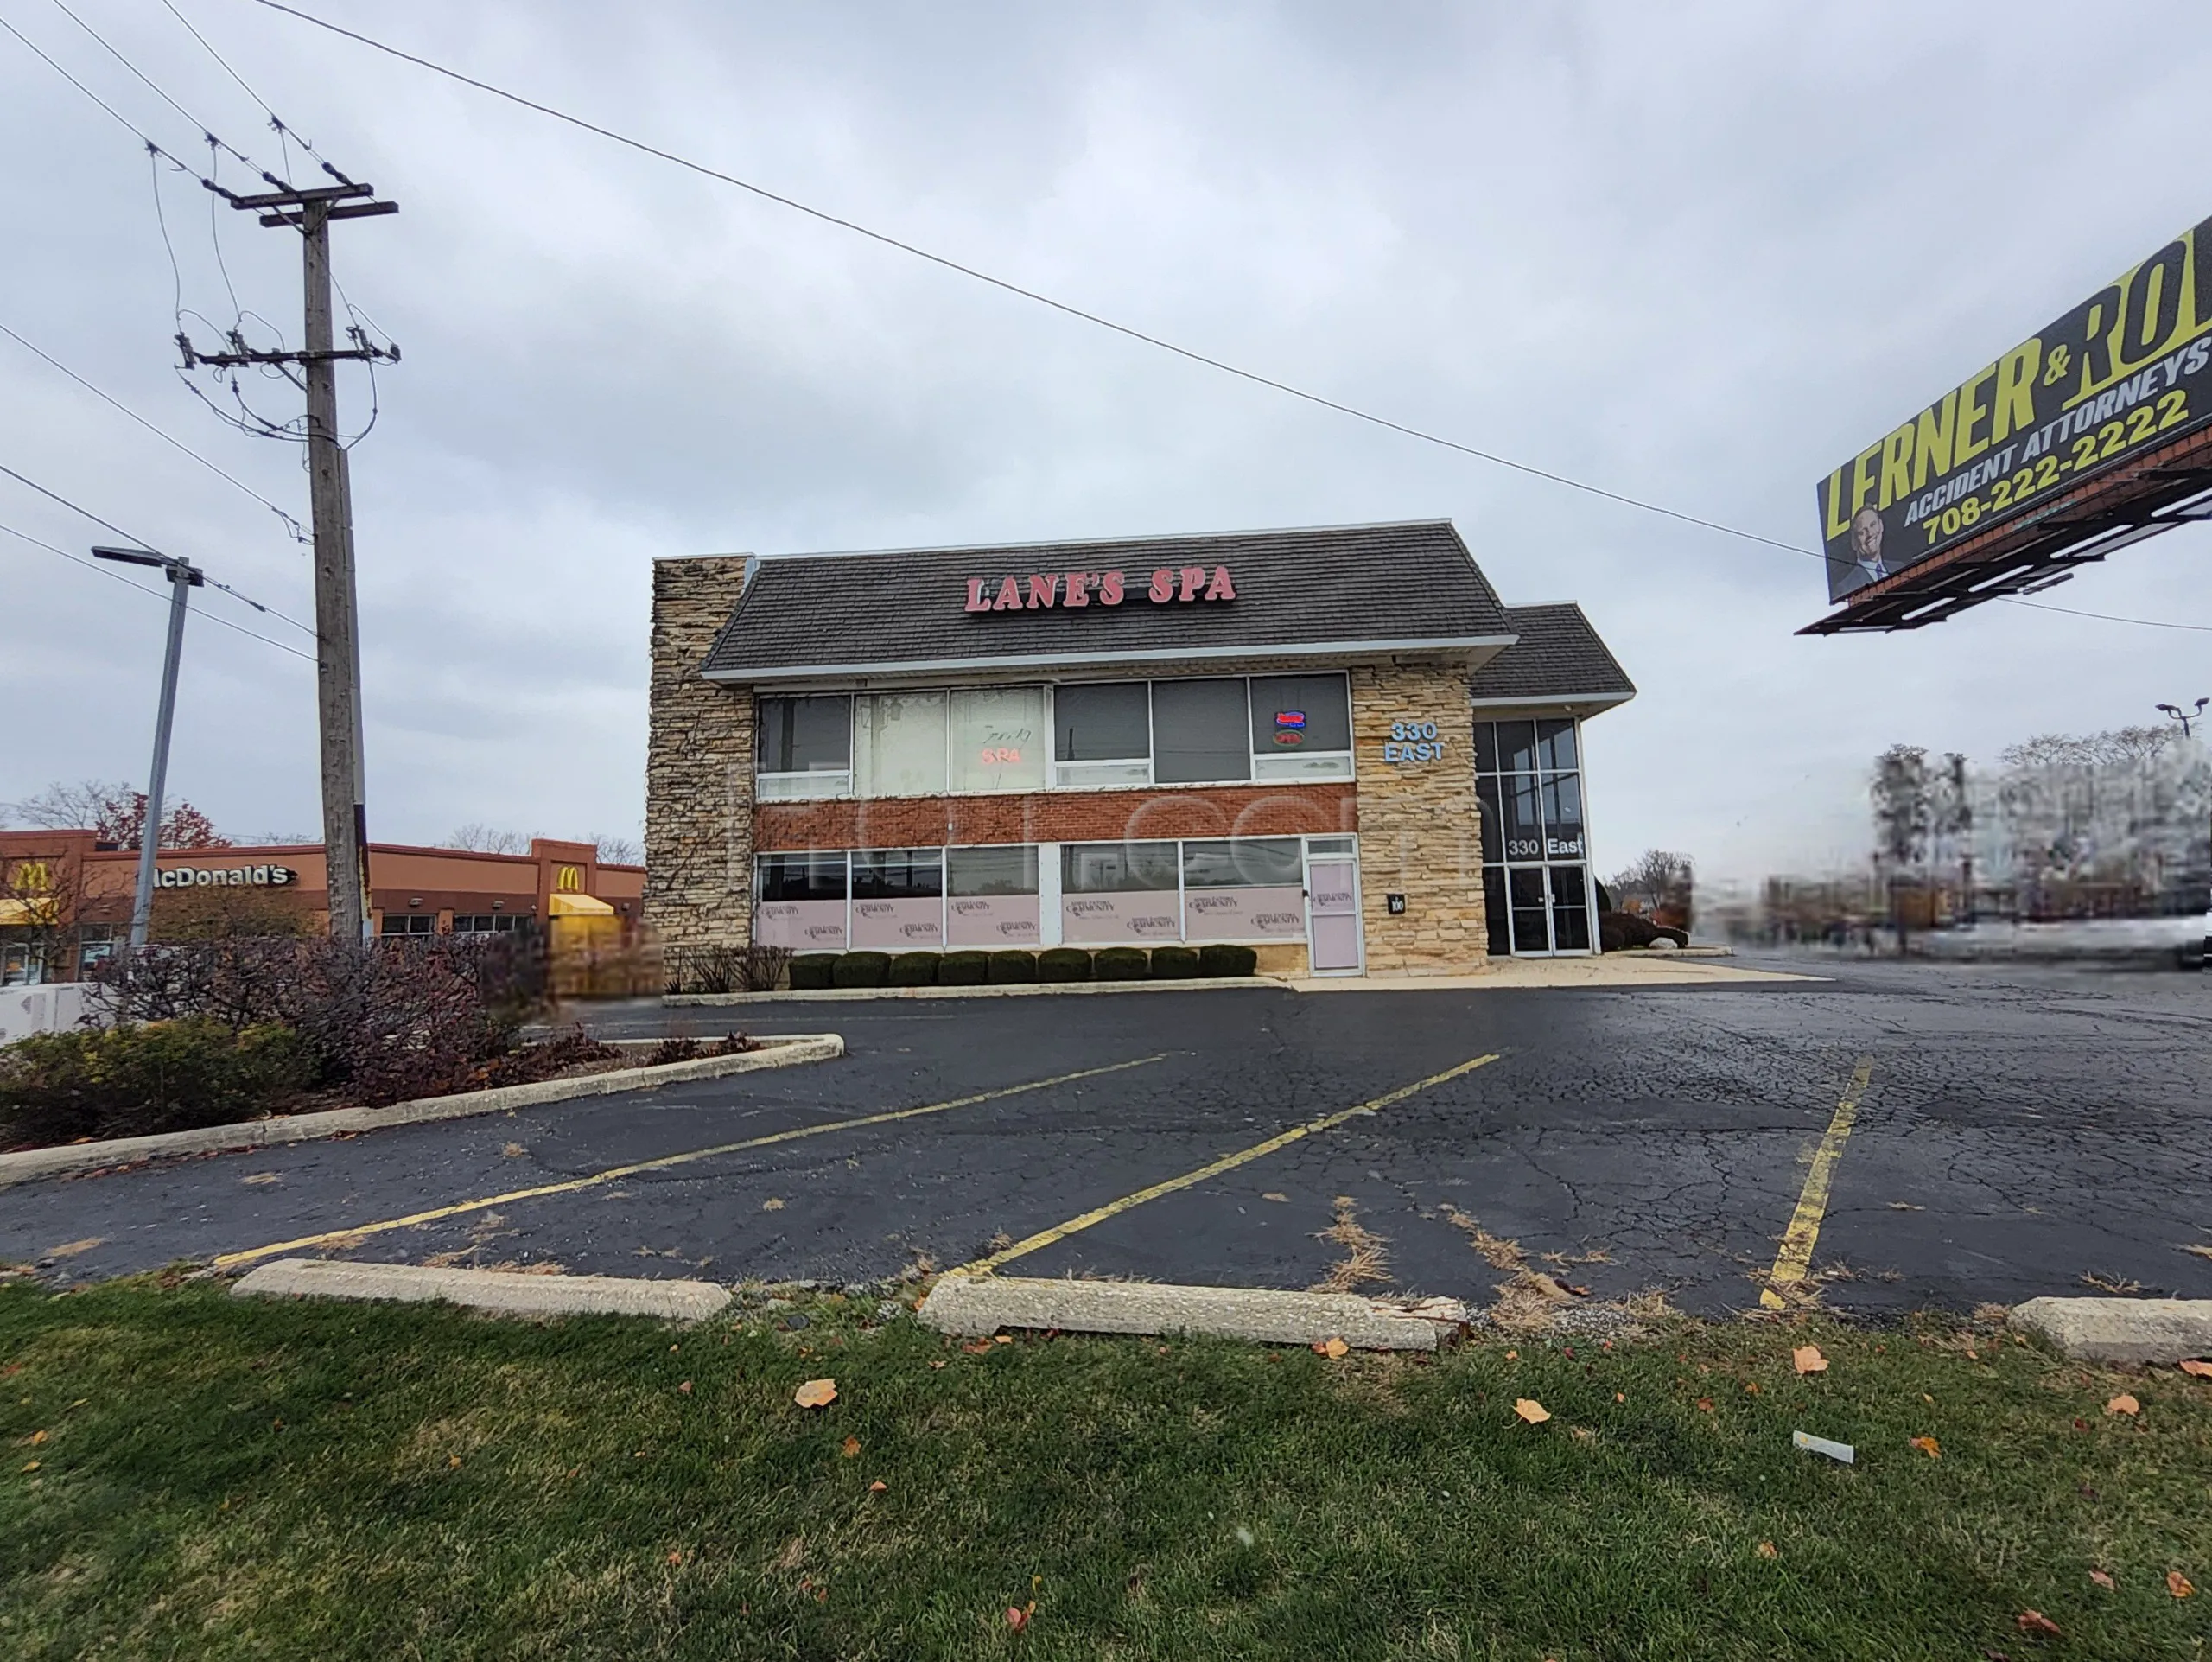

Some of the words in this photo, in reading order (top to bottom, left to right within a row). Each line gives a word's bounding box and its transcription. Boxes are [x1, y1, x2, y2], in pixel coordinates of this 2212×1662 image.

[1827, 337, 2041, 541] LERNER
[2043, 343, 2069, 386] &
[1903, 443, 2018, 528] ACCIDENT
[2020, 336, 2209, 463] ATTORNEYS
[1922, 390, 2190, 544] 708-222-2222
[964, 572, 1125, 612] LANE'S
[1148, 565, 1236, 604] SPA
[1384, 742, 1444, 762] EAST
[1390, 722, 1438, 742] 330
[1508, 839, 1539, 855] 330
[1548, 838, 1583, 854] East
